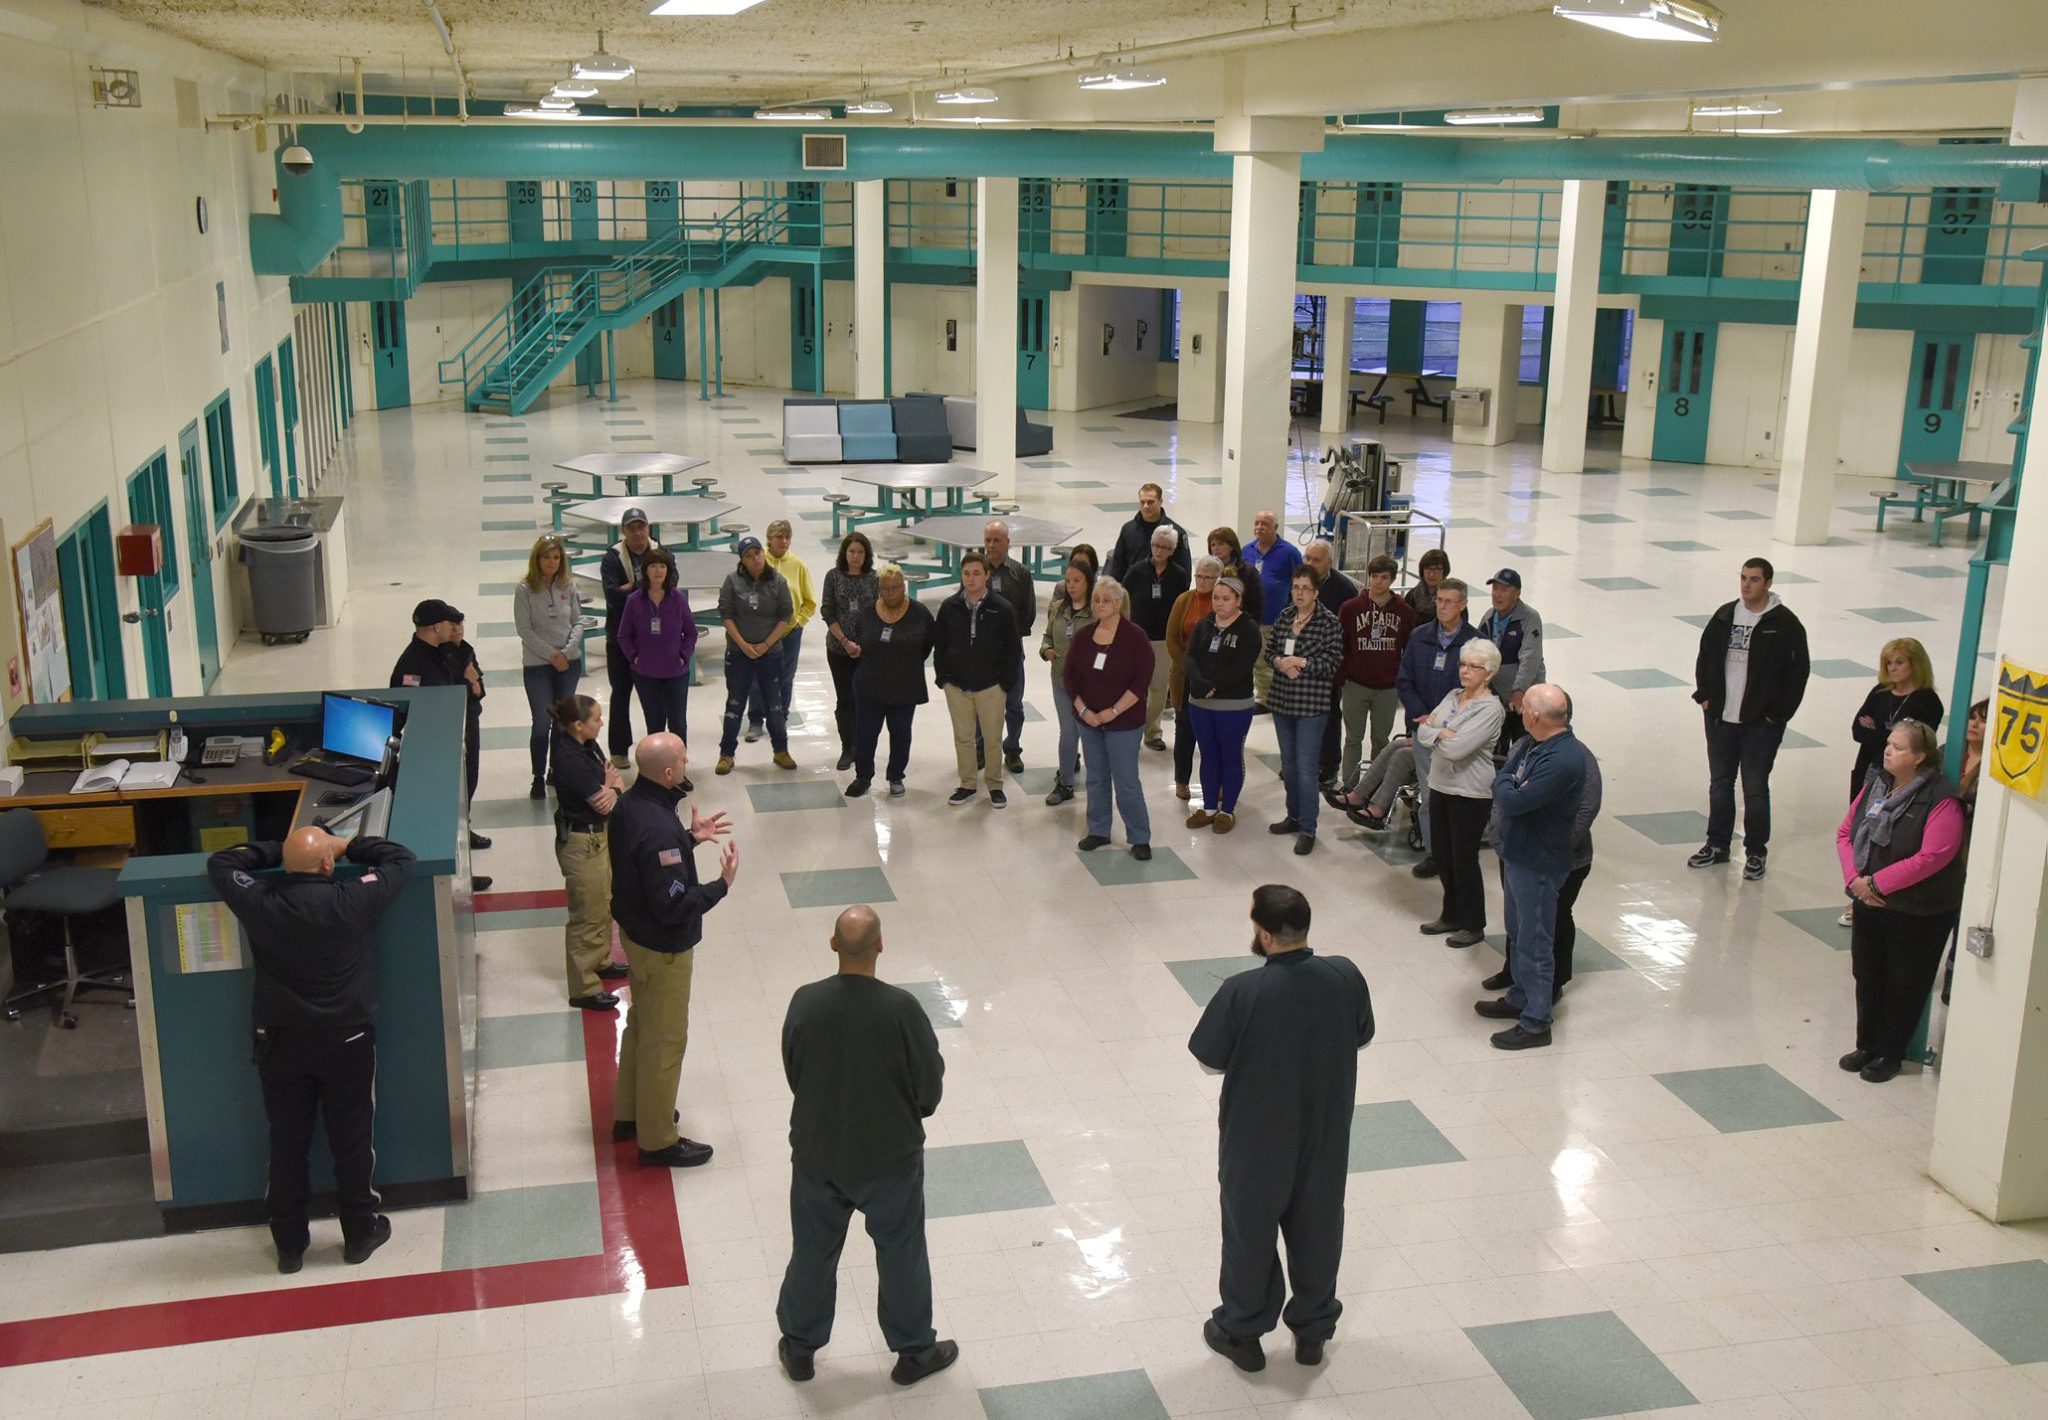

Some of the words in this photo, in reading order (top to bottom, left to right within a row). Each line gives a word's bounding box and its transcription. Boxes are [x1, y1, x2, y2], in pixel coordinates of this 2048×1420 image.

[371, 188, 389, 206] 27
[575, 187, 592, 203] 29
[651, 187, 670, 203] 30
[1683, 209, 1713, 230] 36
[1941, 213, 1977, 236] 37
[663, 329, 674, 345] 4
[803, 339, 813, 355] 5
[386, 351, 394, 368] 1
[1025, 354, 1036, 370] 7
[1674, 397, 1690, 416] 8
[1924, 412, 1941, 434] 9
[1356, 610, 1371, 632] AM
[1999, 705, 2042, 755] 75
